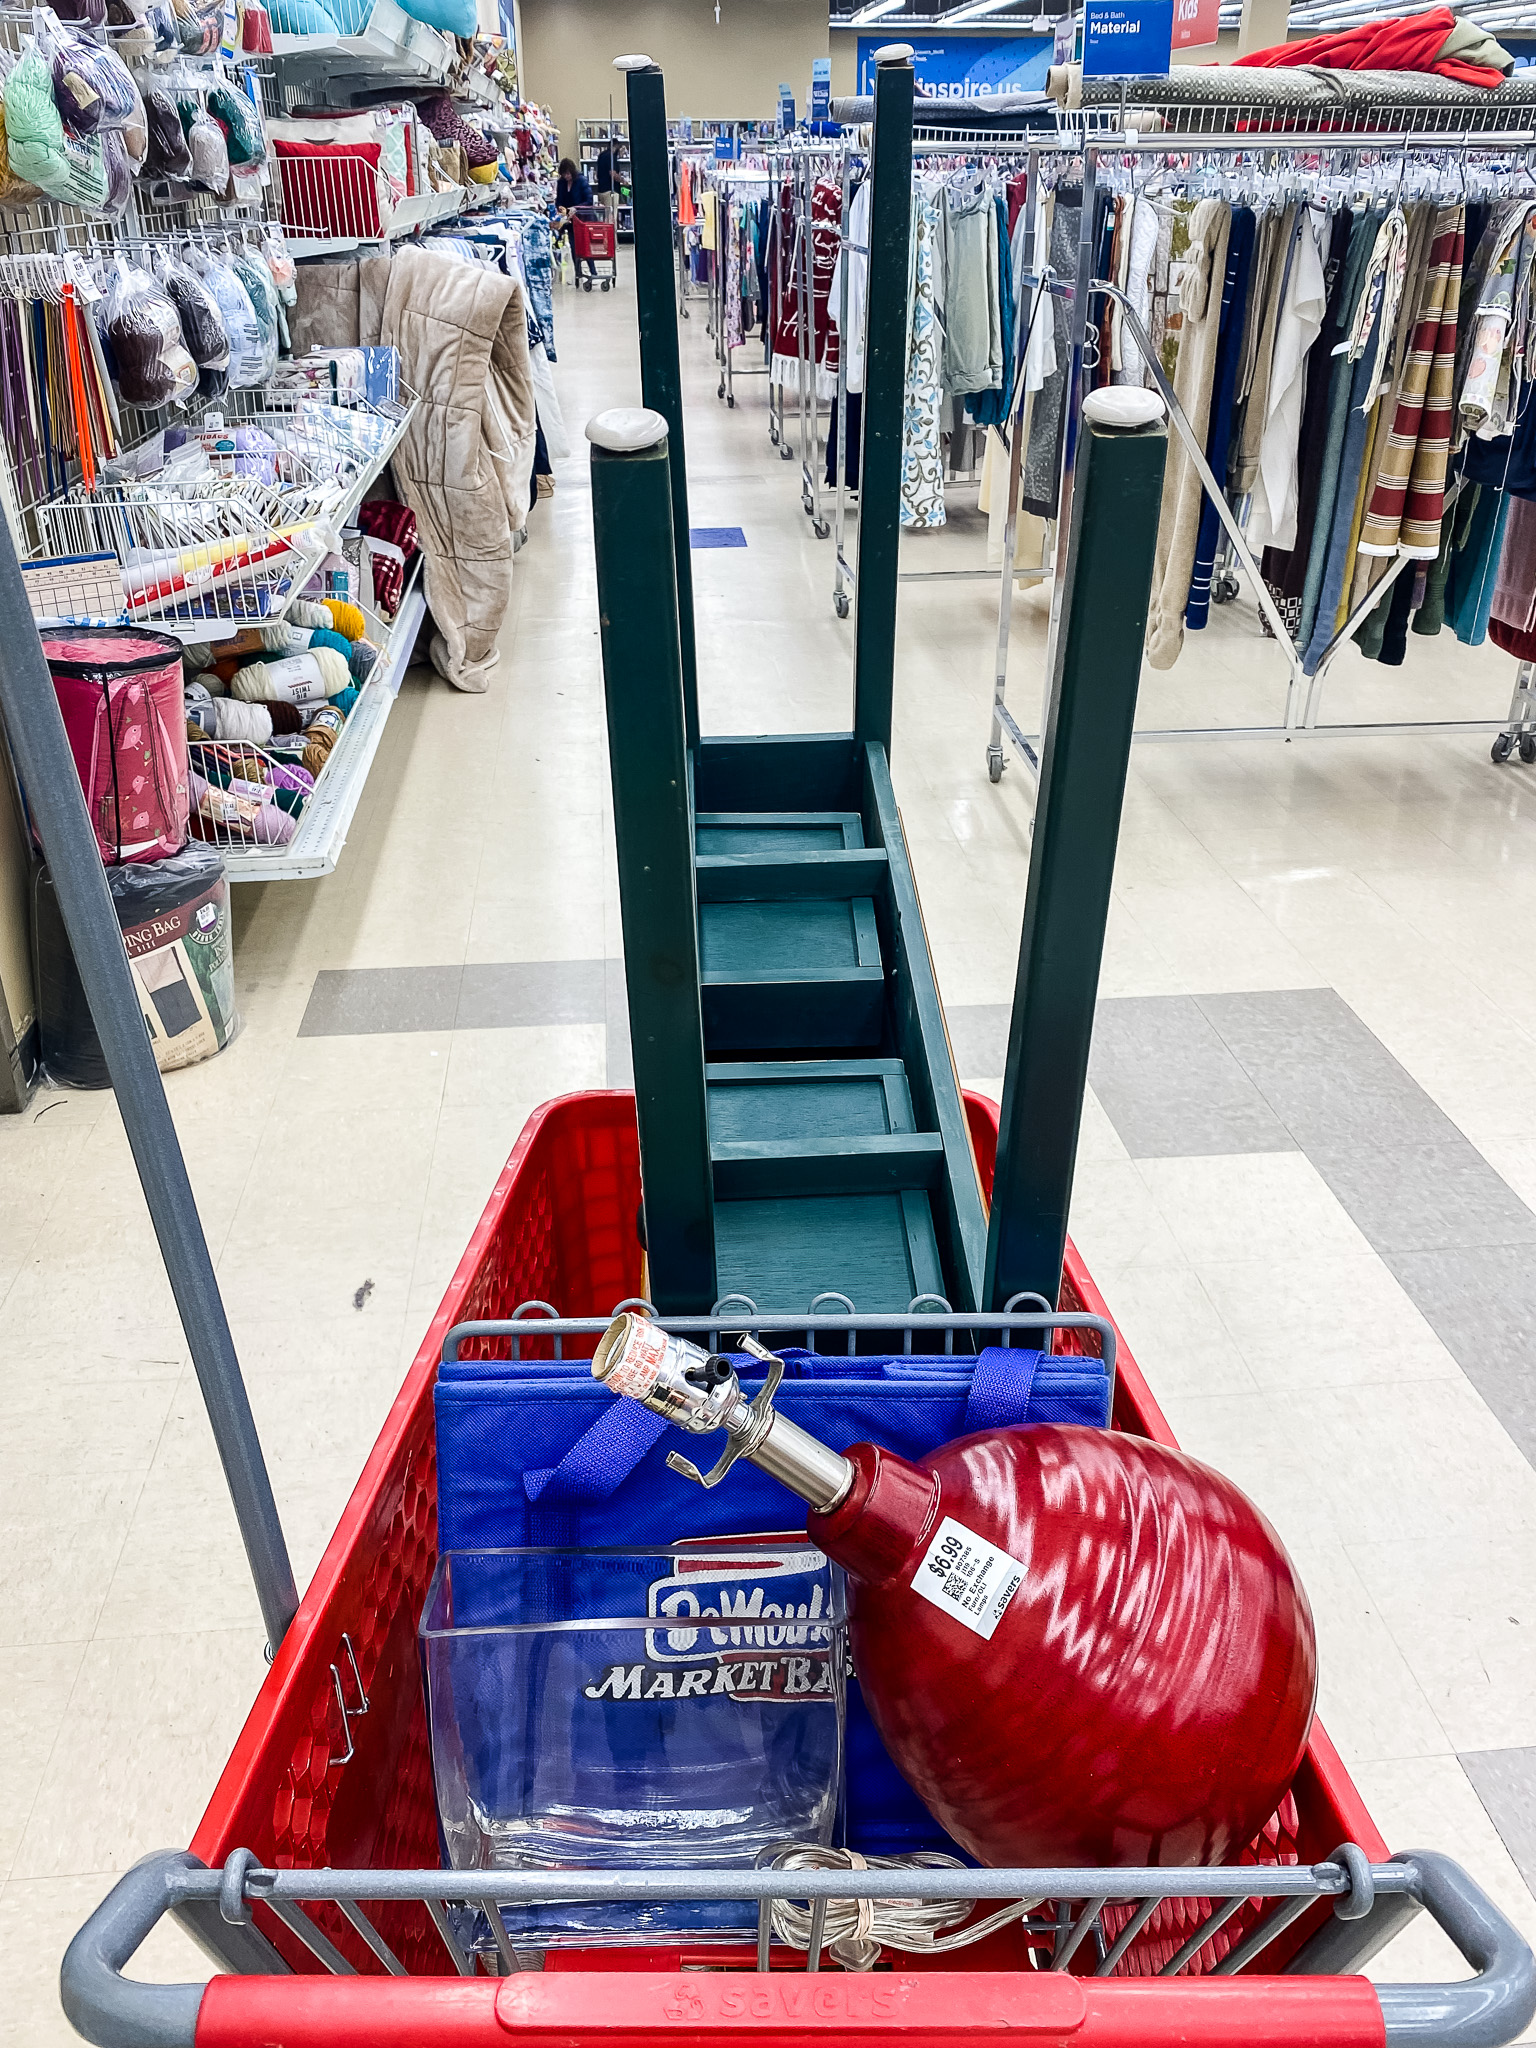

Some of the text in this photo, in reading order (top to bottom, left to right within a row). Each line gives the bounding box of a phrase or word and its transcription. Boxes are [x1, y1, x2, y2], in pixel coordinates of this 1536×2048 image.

[1110, 11, 1125, 19] Bath
[1090, 20, 1141, 35] Material
[919, 77, 1022, 99] inspire us
[292, 685, 311, 696] TWIST
[296, 692, 307, 700] BIG
[123, 928, 153, 948] ING
[927, 1536, 964, 1578] $6.99
[955, 1546, 972, 1571] 807385
[961, 1556, 995, 1609] No Exchange
[997, 1575, 1021, 1610] savers
[974, 1594, 989, 1616] Lamps
[584, 1660, 778, 1700] MARKET
[719, 1985, 898, 2018] savers
